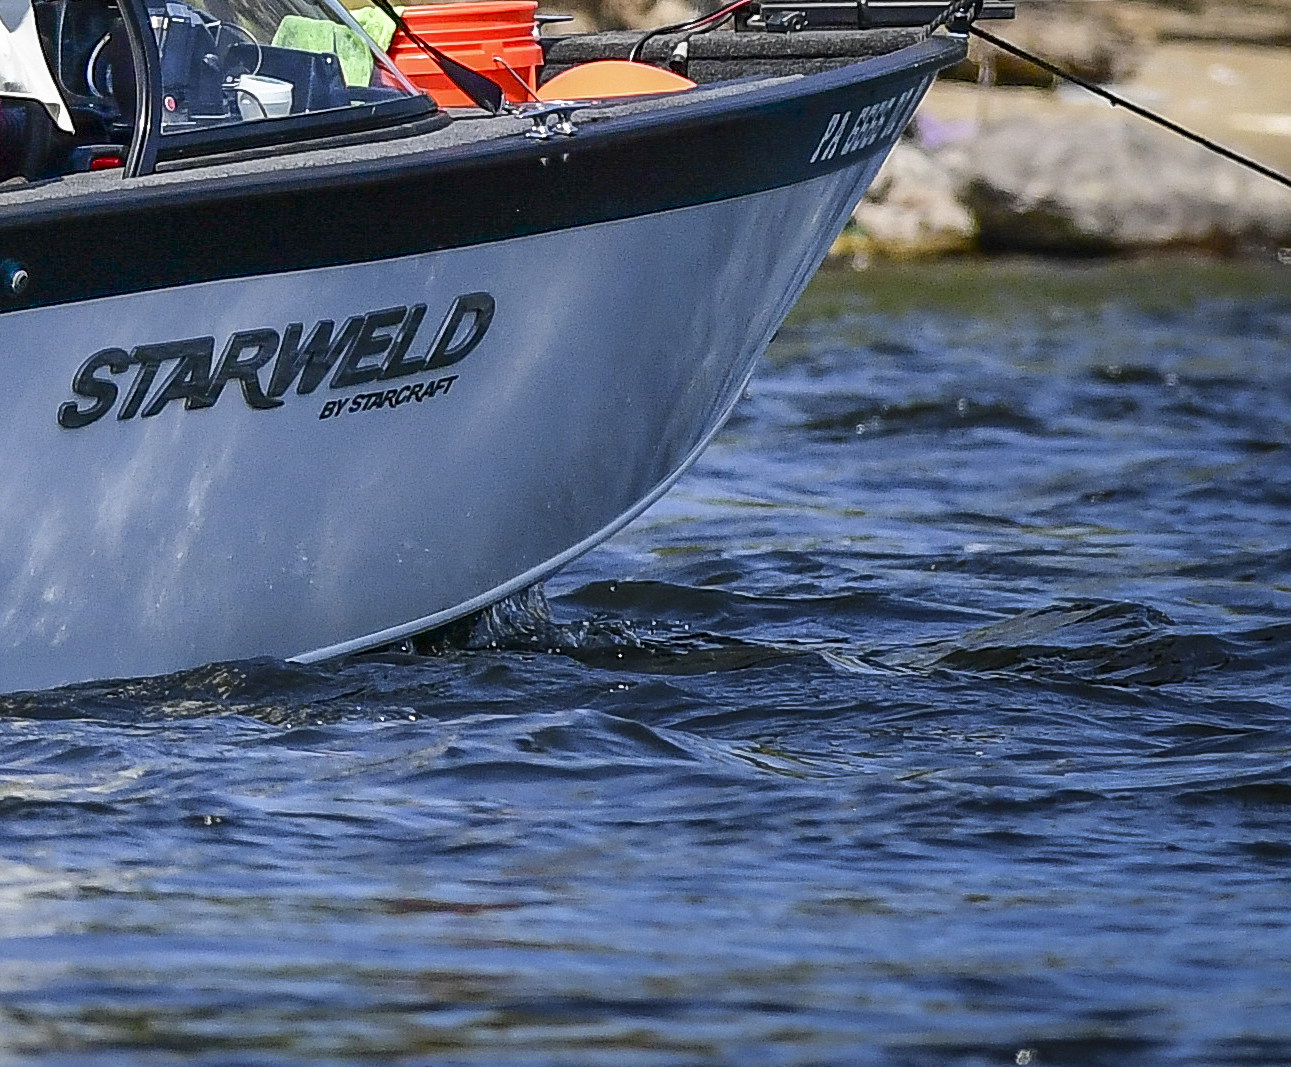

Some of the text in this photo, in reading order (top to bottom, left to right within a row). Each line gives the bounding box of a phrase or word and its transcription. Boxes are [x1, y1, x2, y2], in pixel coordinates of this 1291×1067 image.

[809, 111, 851, 163] PA
[56, 290, 497, 430] STARWELD
[318, 375, 460, 421] BY STARCRAFT
